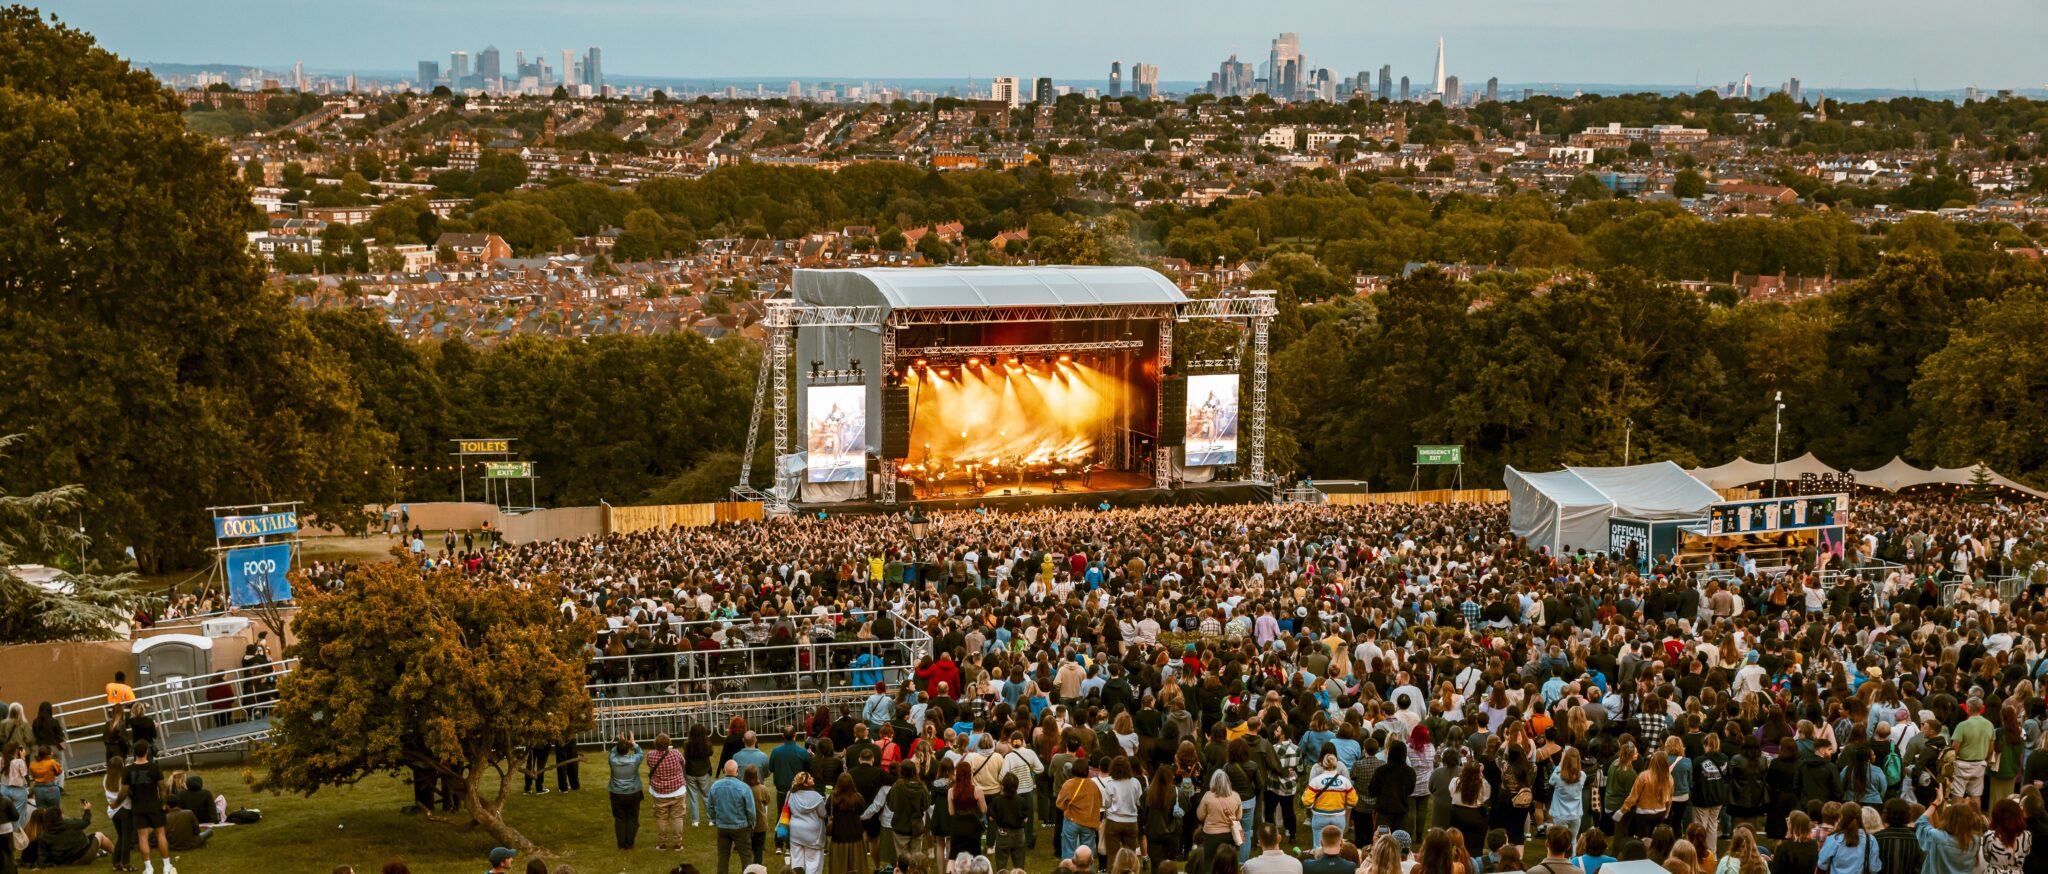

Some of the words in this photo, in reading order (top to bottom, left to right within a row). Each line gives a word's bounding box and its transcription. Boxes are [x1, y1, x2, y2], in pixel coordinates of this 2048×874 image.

[461, 441, 507, 452] TOILETS
[1801, 472, 1855, 492] BAR
[224, 513, 297, 536] COCKTAILS
[1611, 524, 1647, 538] OFFICIAL
[244, 559, 276, 576] FOOD
